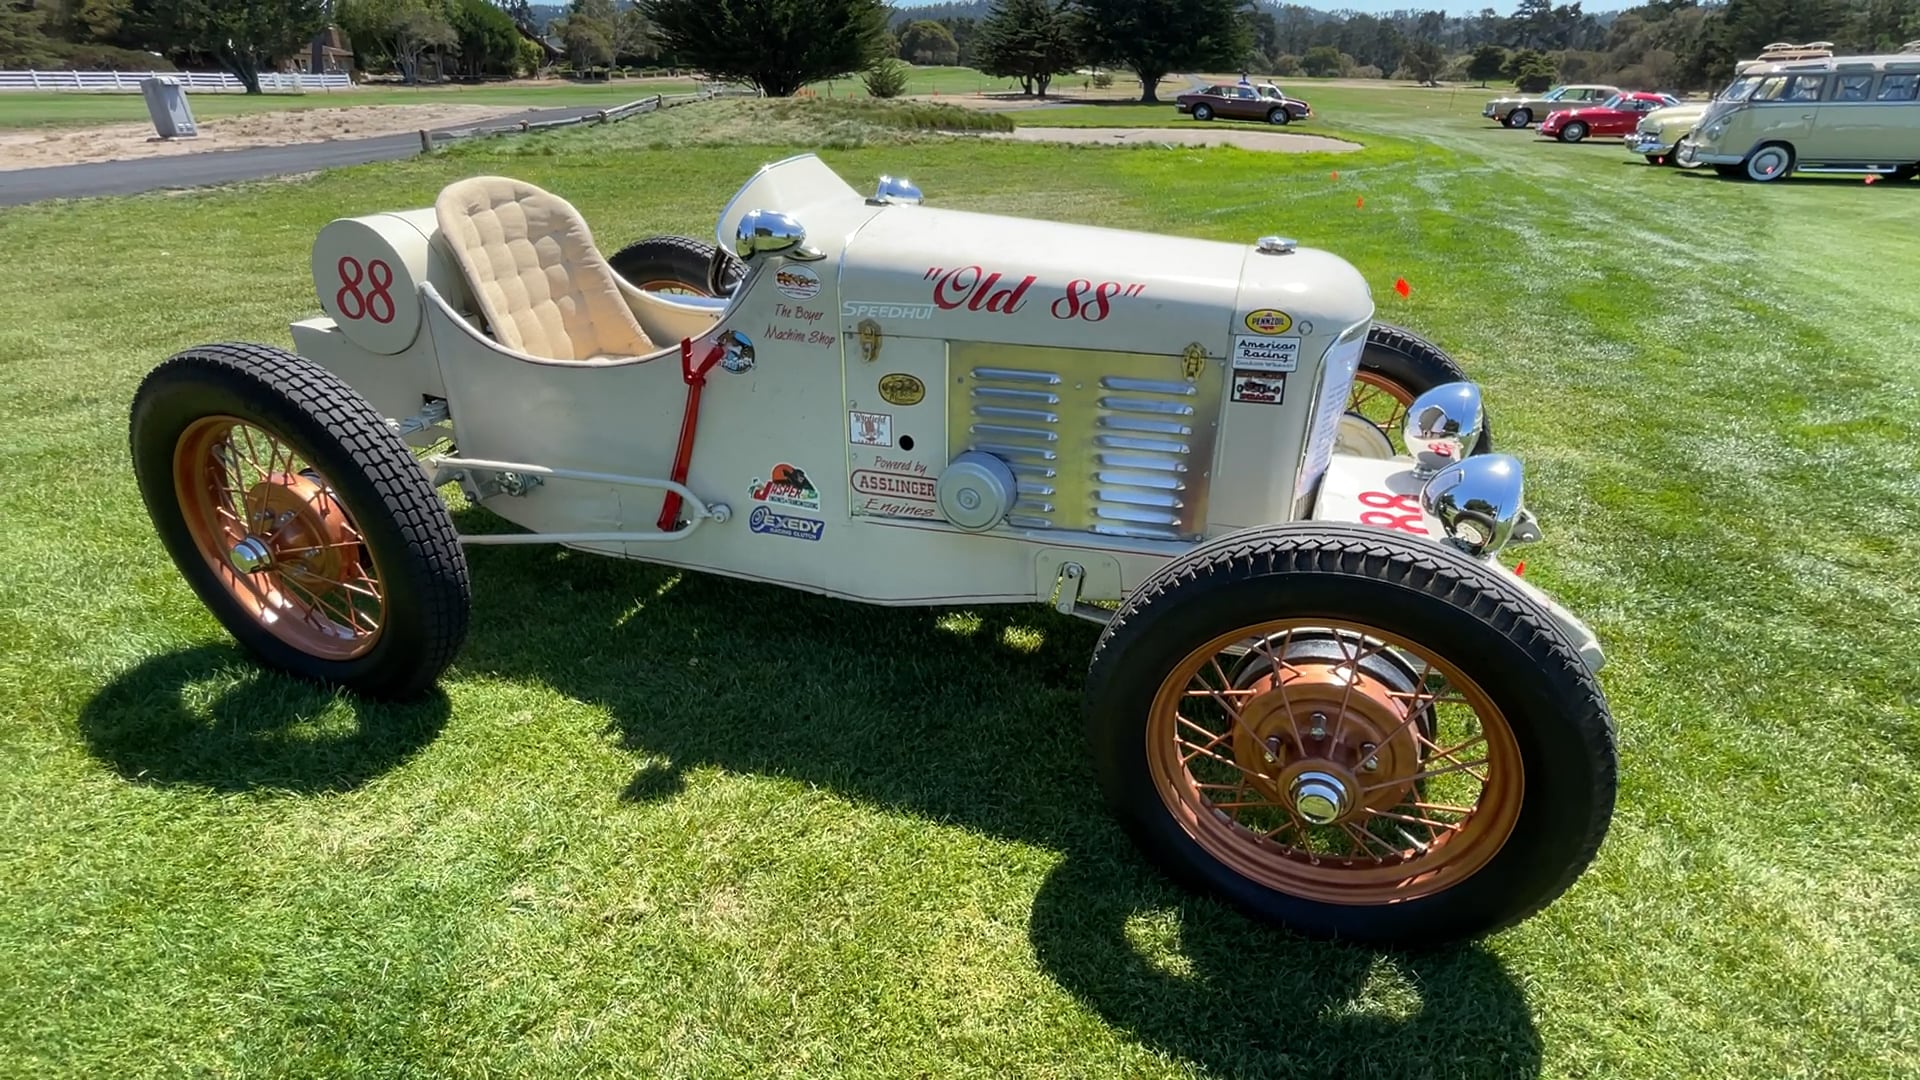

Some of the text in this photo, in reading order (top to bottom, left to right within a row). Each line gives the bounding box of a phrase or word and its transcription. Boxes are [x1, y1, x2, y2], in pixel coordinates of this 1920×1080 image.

[336, 255, 396, 325] 88
[775, 303, 824, 326] The Boyer
[1252, 316, 1284, 326] PENNZOIL
[764, 322, 836, 349] Machine Shop
[1238, 340, 1297, 350] American
[1243, 349, 1289, 363] Racing
[874, 455, 928, 477] Powered by
[752, 480, 803, 501] JASPER
[859, 475, 936, 497] ASSLINGER
[864, 498, 936, 517] Engines
[763, 514, 823, 534] EXEDY
